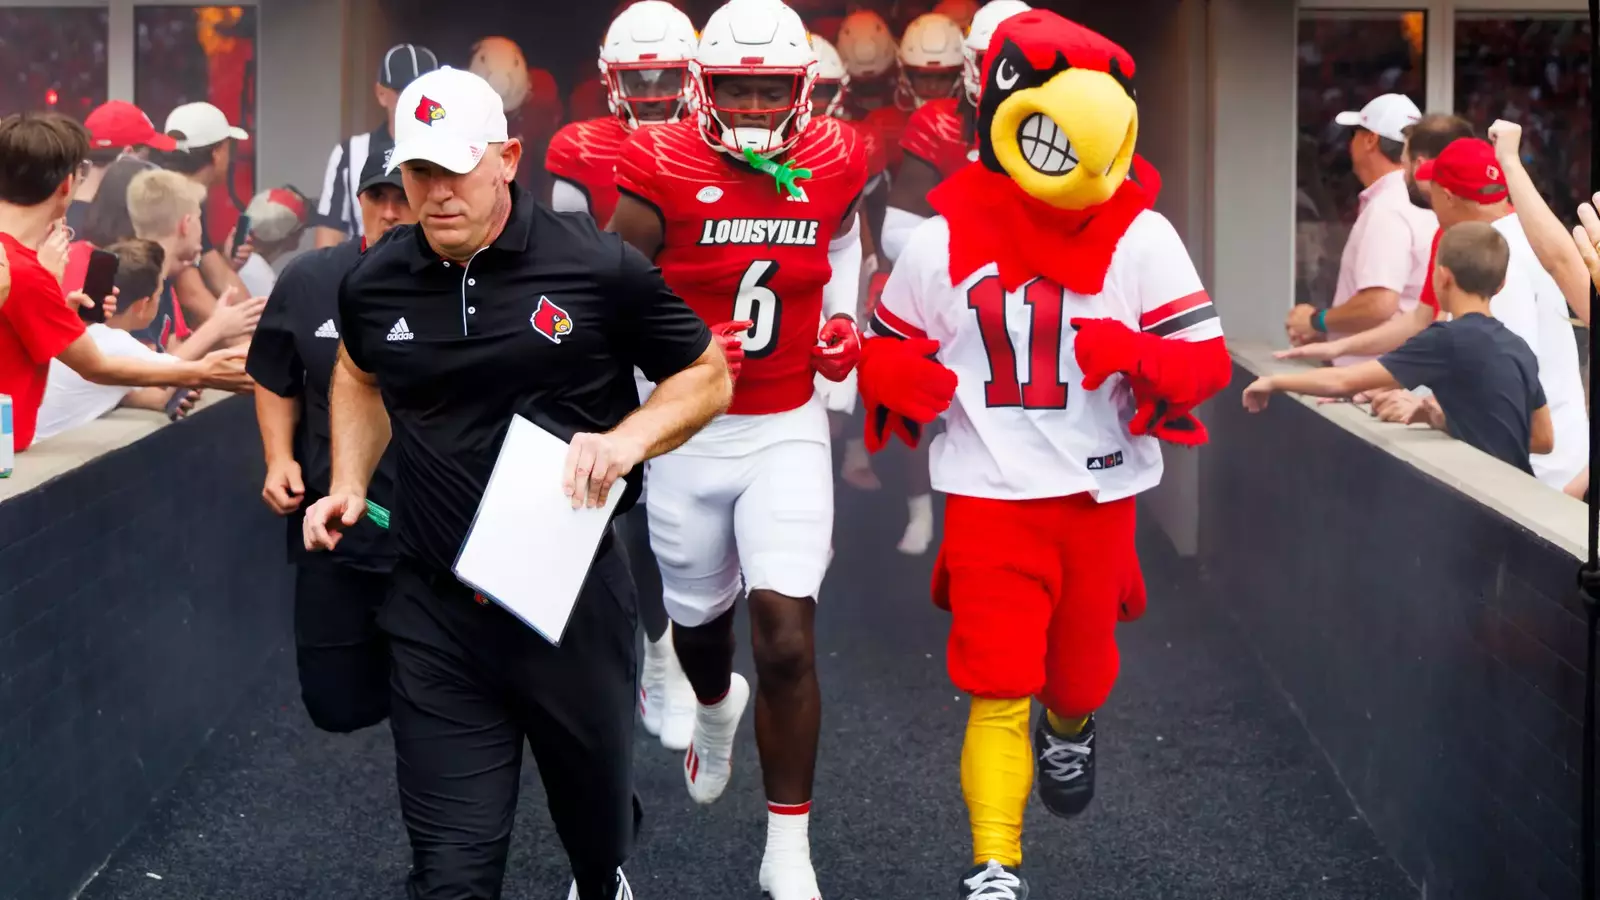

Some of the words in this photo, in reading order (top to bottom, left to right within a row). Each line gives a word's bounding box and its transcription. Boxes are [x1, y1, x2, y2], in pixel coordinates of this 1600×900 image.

[698, 218, 819, 246] LOUISVILLE
[386, 332, 414, 340] adidas
[733, 259, 781, 357] 6
[967, 275, 1068, 410] 11
